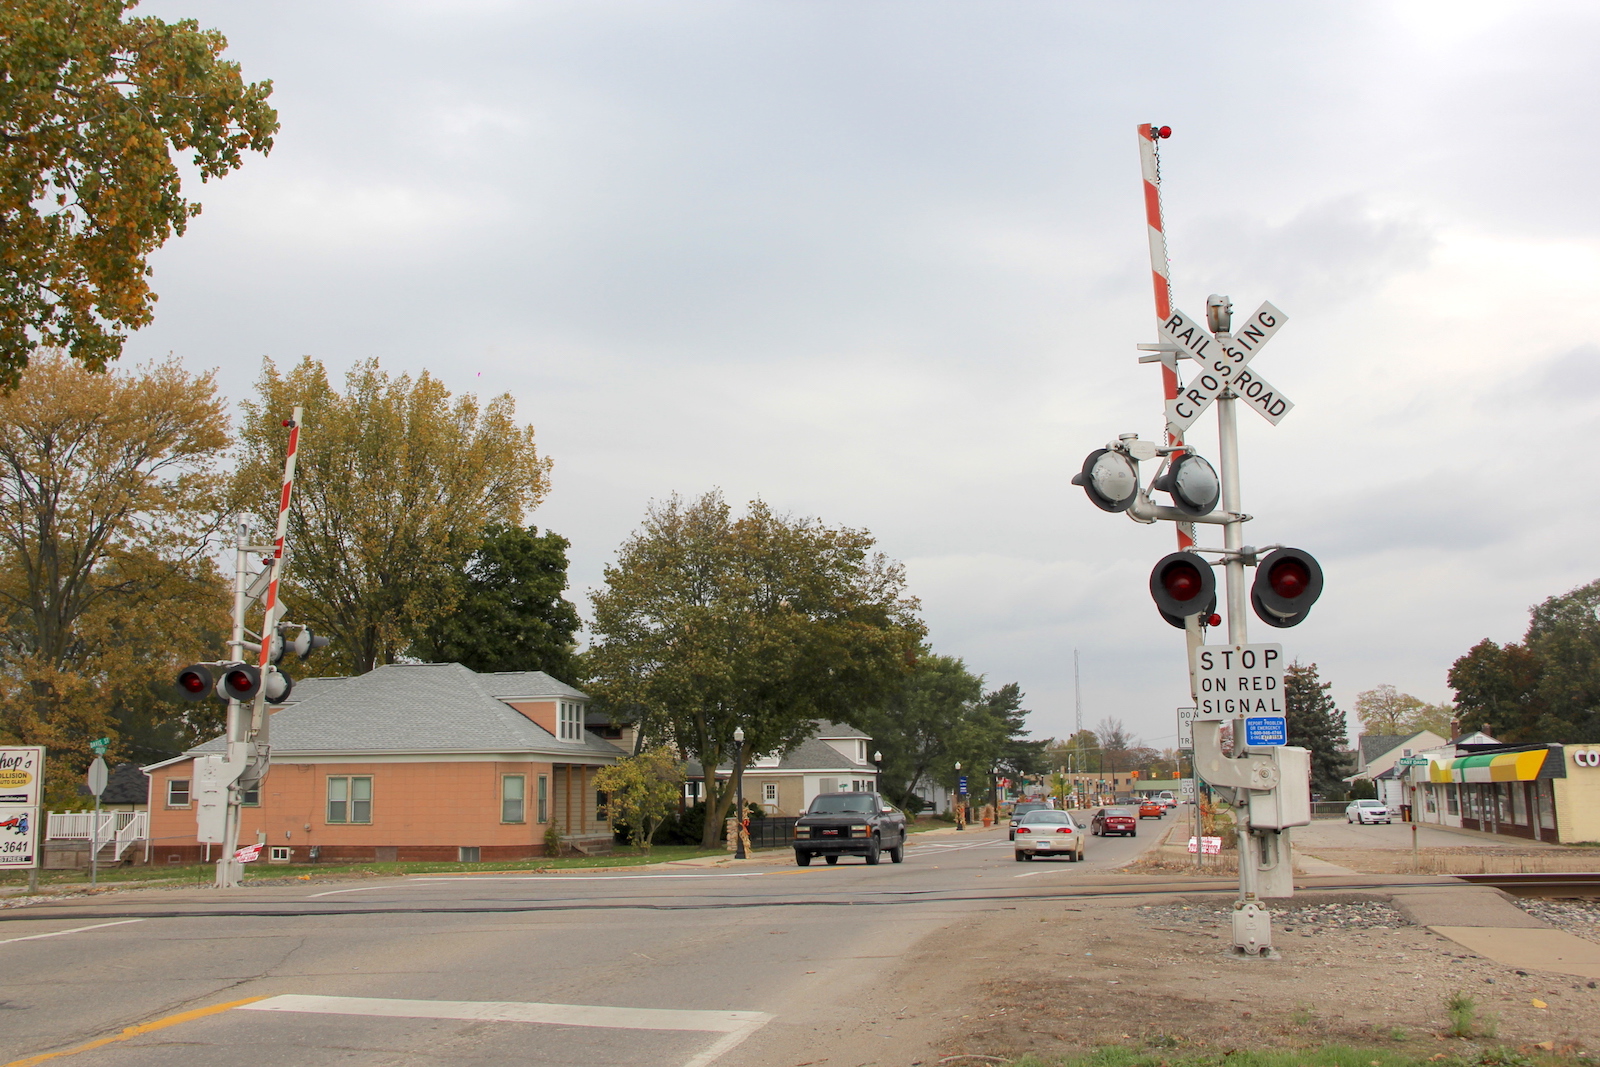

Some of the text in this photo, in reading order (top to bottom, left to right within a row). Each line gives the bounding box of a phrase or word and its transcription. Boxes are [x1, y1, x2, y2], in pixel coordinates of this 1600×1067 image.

[1164, 314, 1287, 417] RAIL ROAD
[1175, 311, 1276, 419] CROSSING
[1200, 649, 1278, 671] STOP
[1201, 676, 1277, 692] ON RED
[1202, 697, 1282, 714] SIGNAL
[1180, 711, 1191, 719] DO
[1182, 786, 1194, 794] 30
